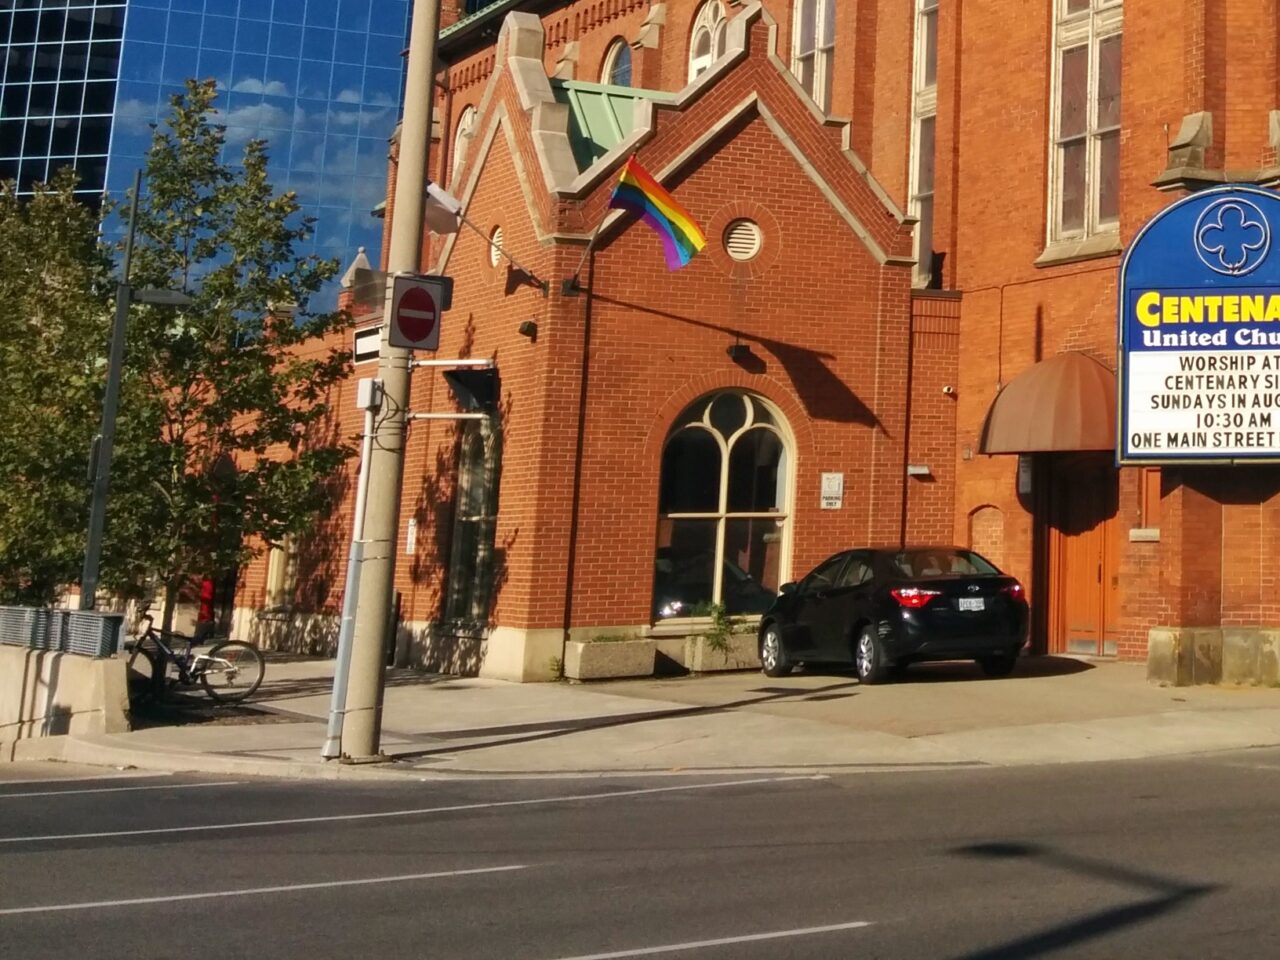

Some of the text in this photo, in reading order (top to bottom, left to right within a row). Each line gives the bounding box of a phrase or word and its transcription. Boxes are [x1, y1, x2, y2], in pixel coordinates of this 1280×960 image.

[1142, 328, 1228, 347] United
[1179, 355, 1256, 371] WORSHIP
[1164, 374, 1260, 390] CENTENARY
[1151, 394, 1227, 409] SUNDAYS
[1231, 393, 1247, 408] IN
[1196, 412, 1272, 428] 10:30 AM
[1131, 432, 1162, 448] ONE
[1166, 432, 1207, 447] MAIN
[1212, 431, 1275, 447] STREET
